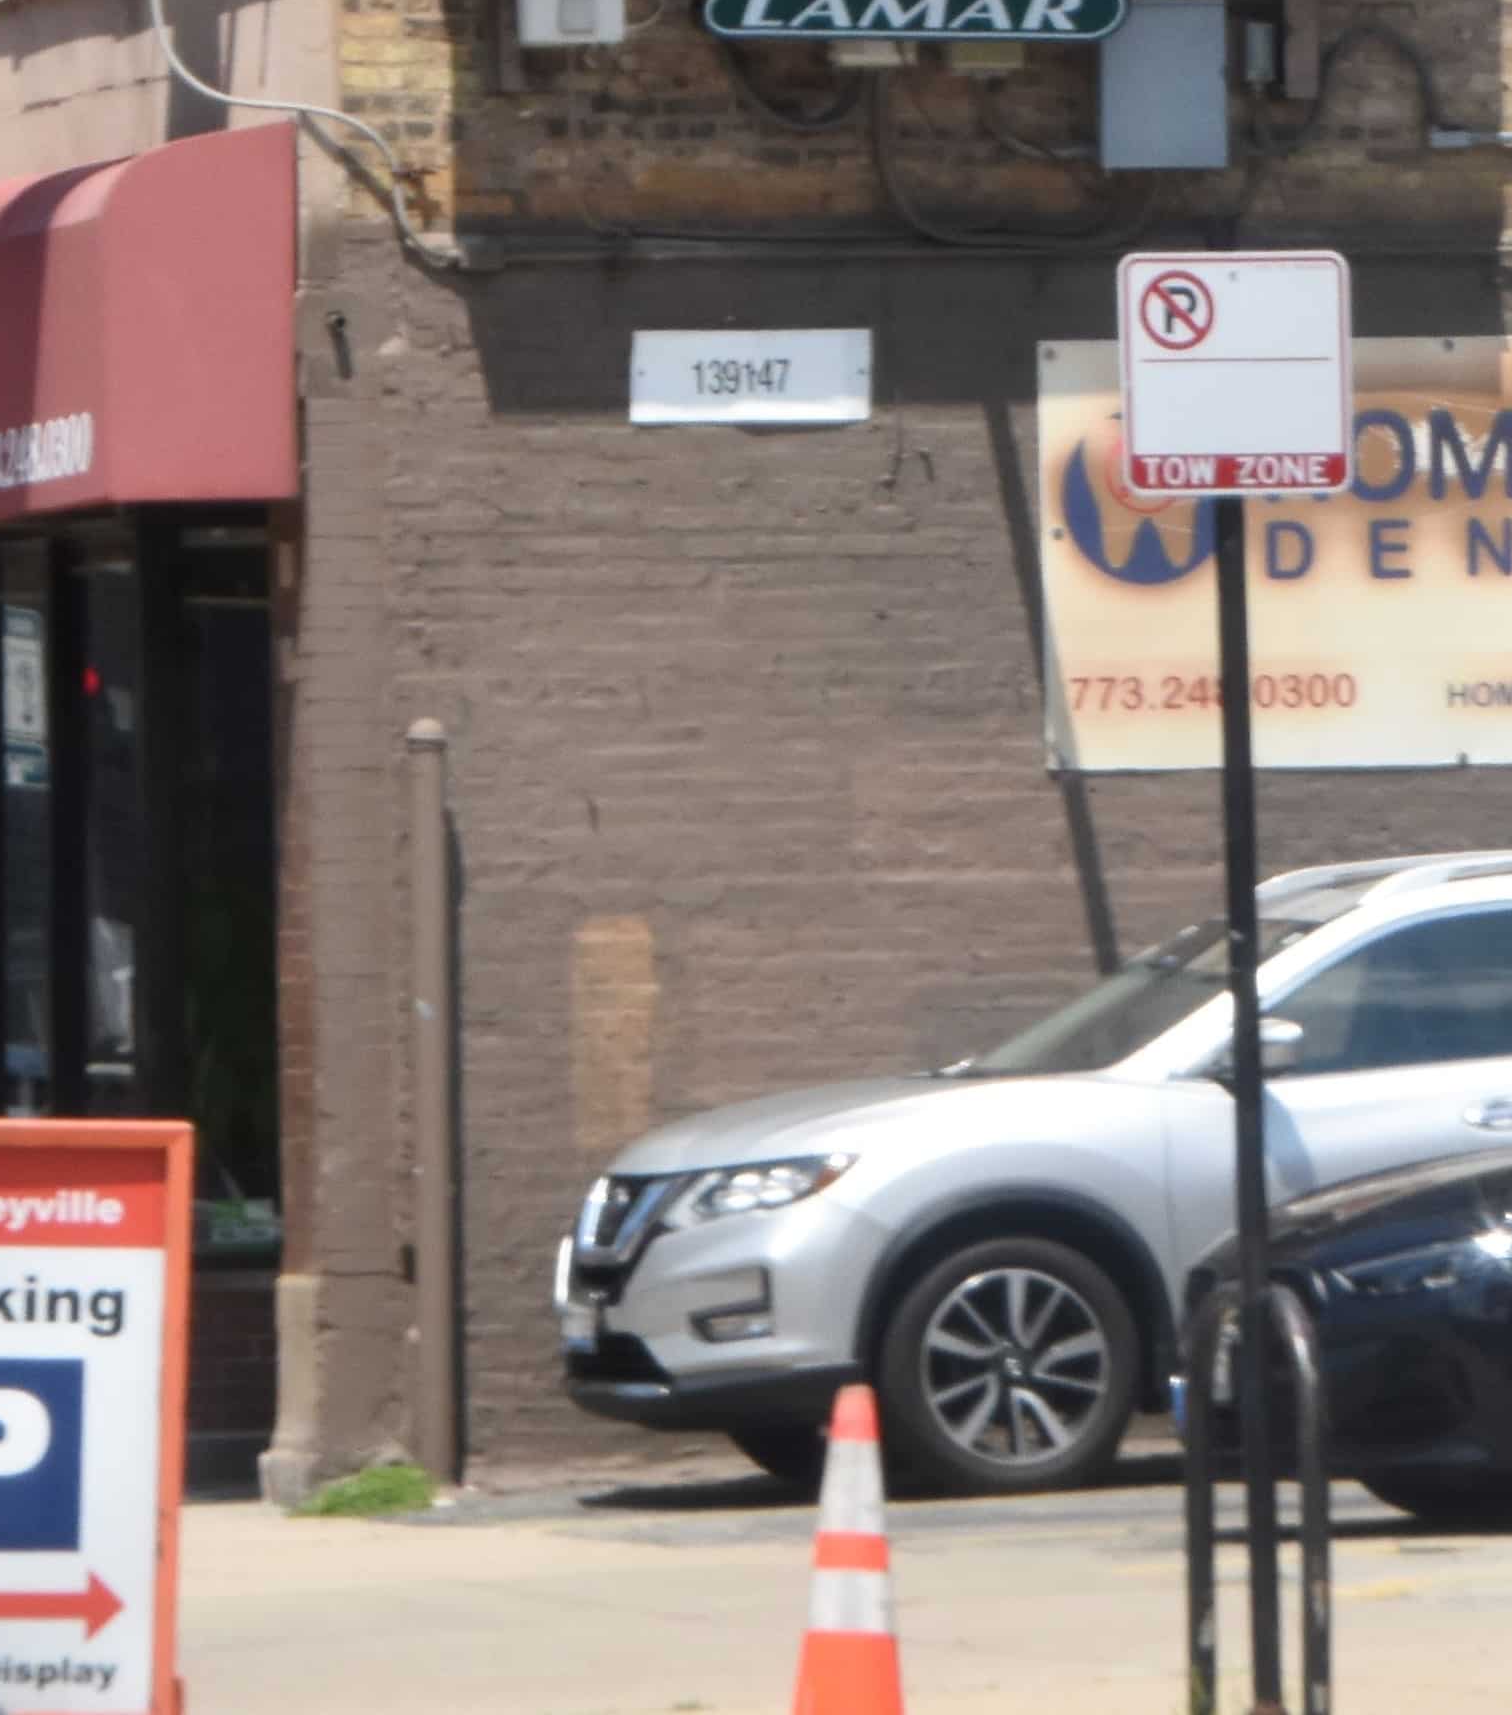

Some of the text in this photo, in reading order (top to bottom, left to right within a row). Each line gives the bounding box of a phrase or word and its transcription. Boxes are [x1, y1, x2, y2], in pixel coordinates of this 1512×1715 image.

[690, 359, 790, 395] 139147
[1141, 455, 1330, 486] TOW ZONE
